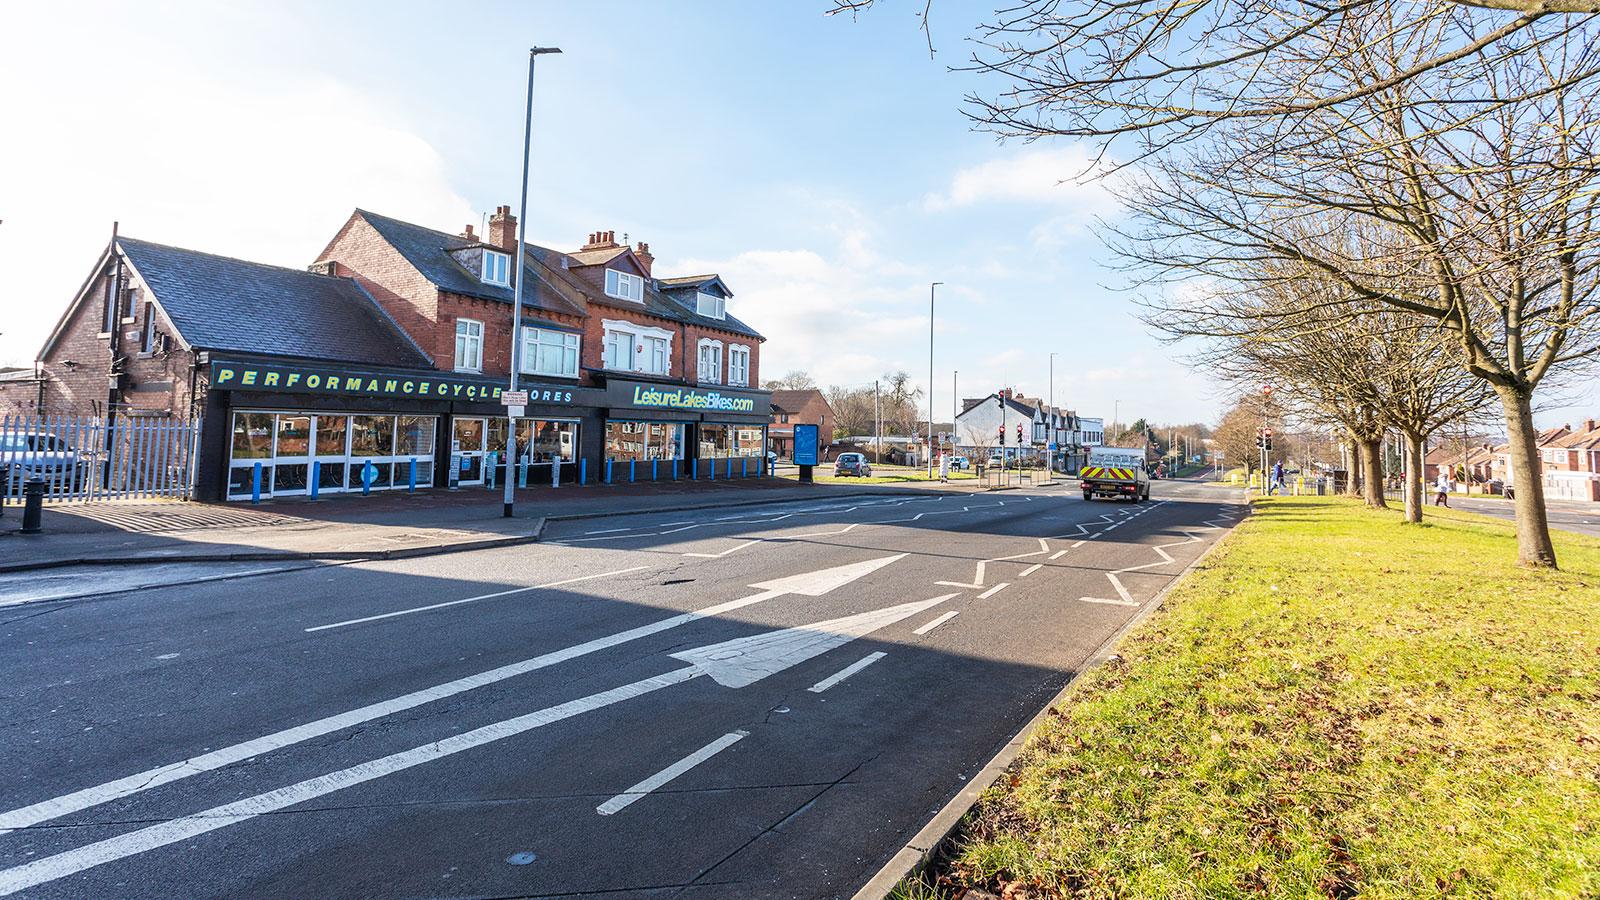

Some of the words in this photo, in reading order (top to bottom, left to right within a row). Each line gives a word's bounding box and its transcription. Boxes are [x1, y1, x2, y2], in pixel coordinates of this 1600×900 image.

[217, 368, 430, 395] PERFORMANCE
[437, 382, 502, 399] CYCLE
[508, 388, 572, 403] ORES
[633, 386, 754, 411] LeisureLakesBikes.com
